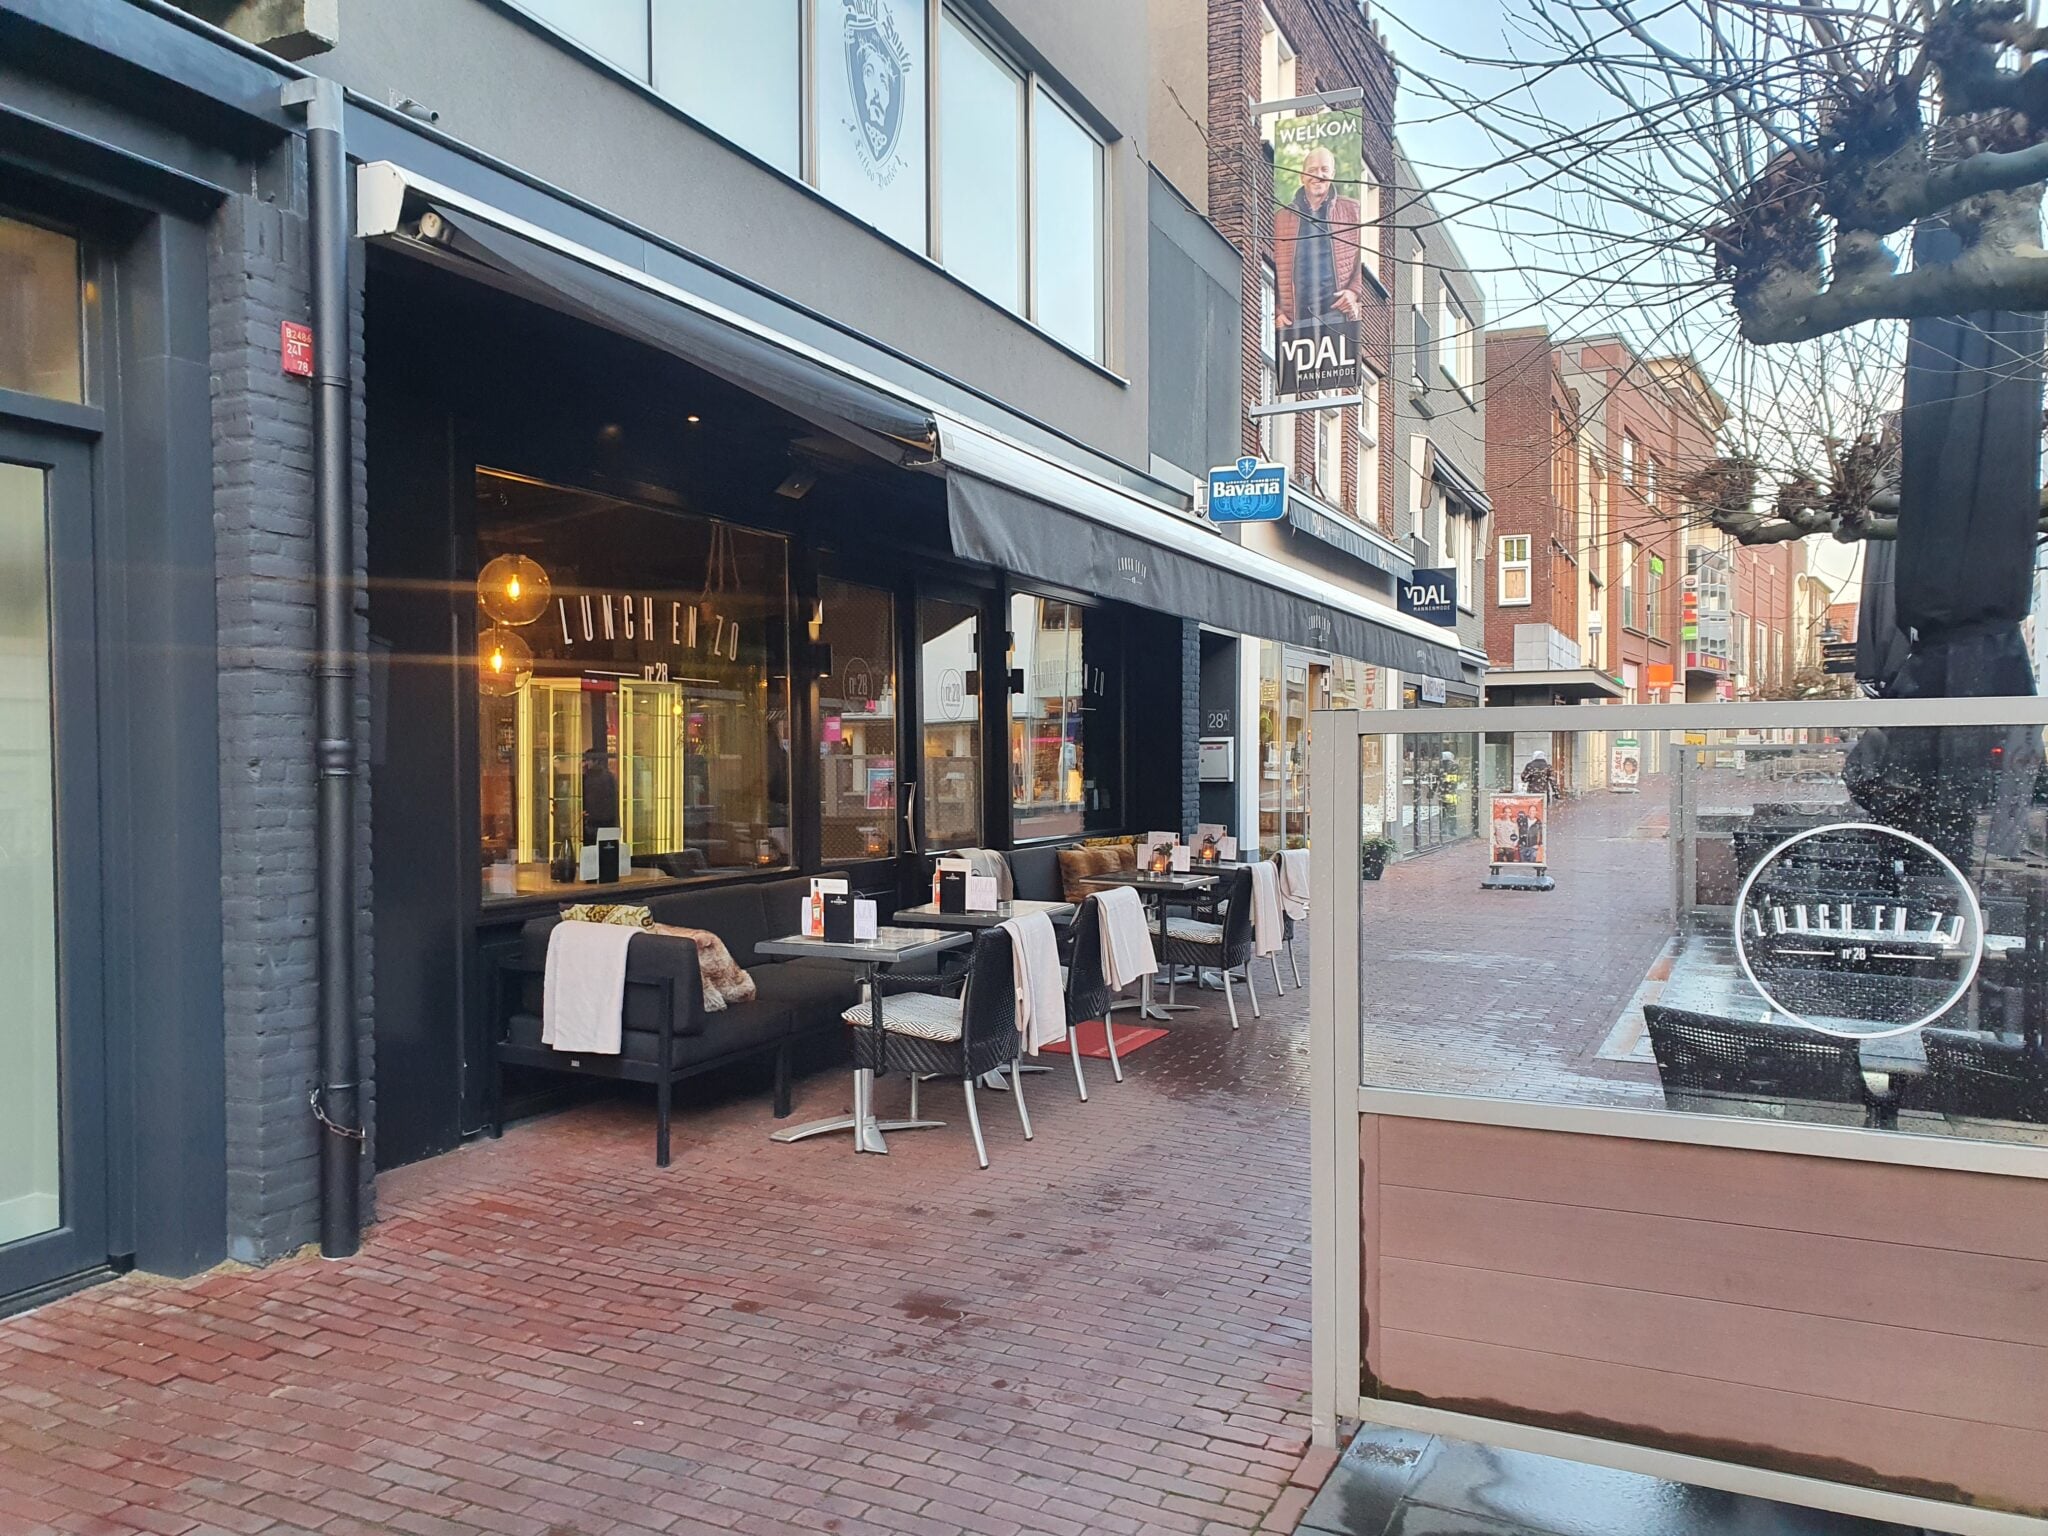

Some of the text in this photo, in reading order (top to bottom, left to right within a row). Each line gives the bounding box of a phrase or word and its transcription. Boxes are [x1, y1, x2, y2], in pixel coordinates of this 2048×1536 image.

[1280, 118, 1356, 143] WELKOM
[1297, 367, 1356, 381] MANNENMODE
[1213, 481, 1280, 498] Bavaria
[558, 594, 739, 662] LUNCH EN ZO
[1753, 903, 1965, 944] LUNCH EN ZO
